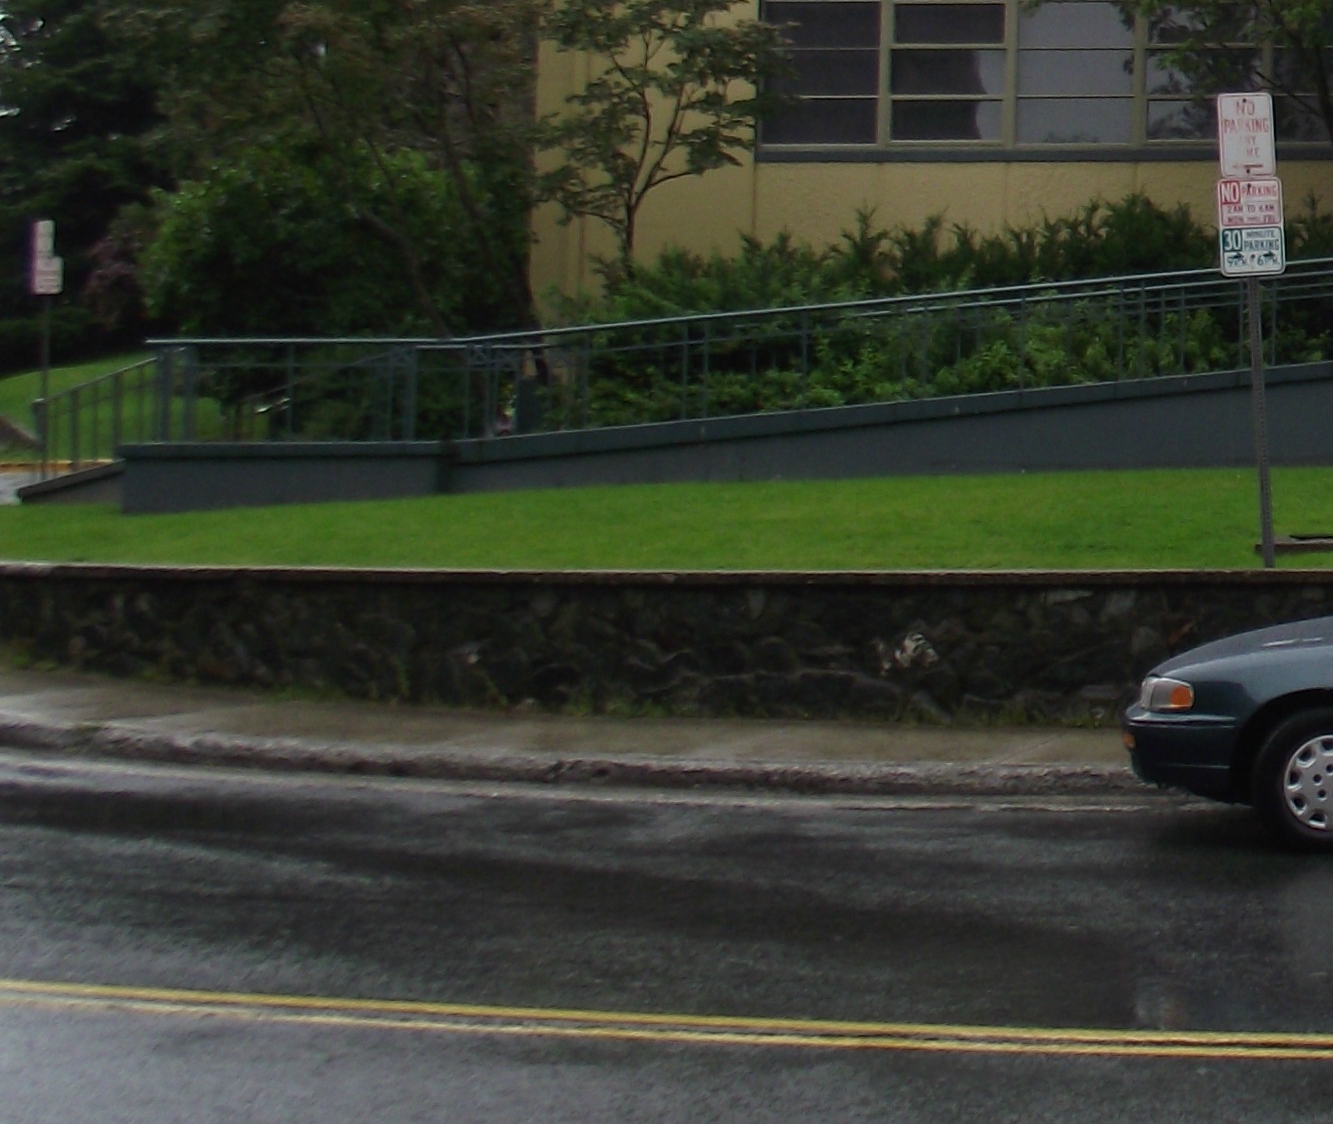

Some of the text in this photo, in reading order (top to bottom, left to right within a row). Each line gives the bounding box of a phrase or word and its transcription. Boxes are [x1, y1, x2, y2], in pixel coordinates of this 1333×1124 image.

[1236, 101, 1255, 116] NO
[1221, 181, 1278, 203] NO PARKING
[1223, 230, 1242, 251] 30
[1243, 238, 1280, 252] PARKING
